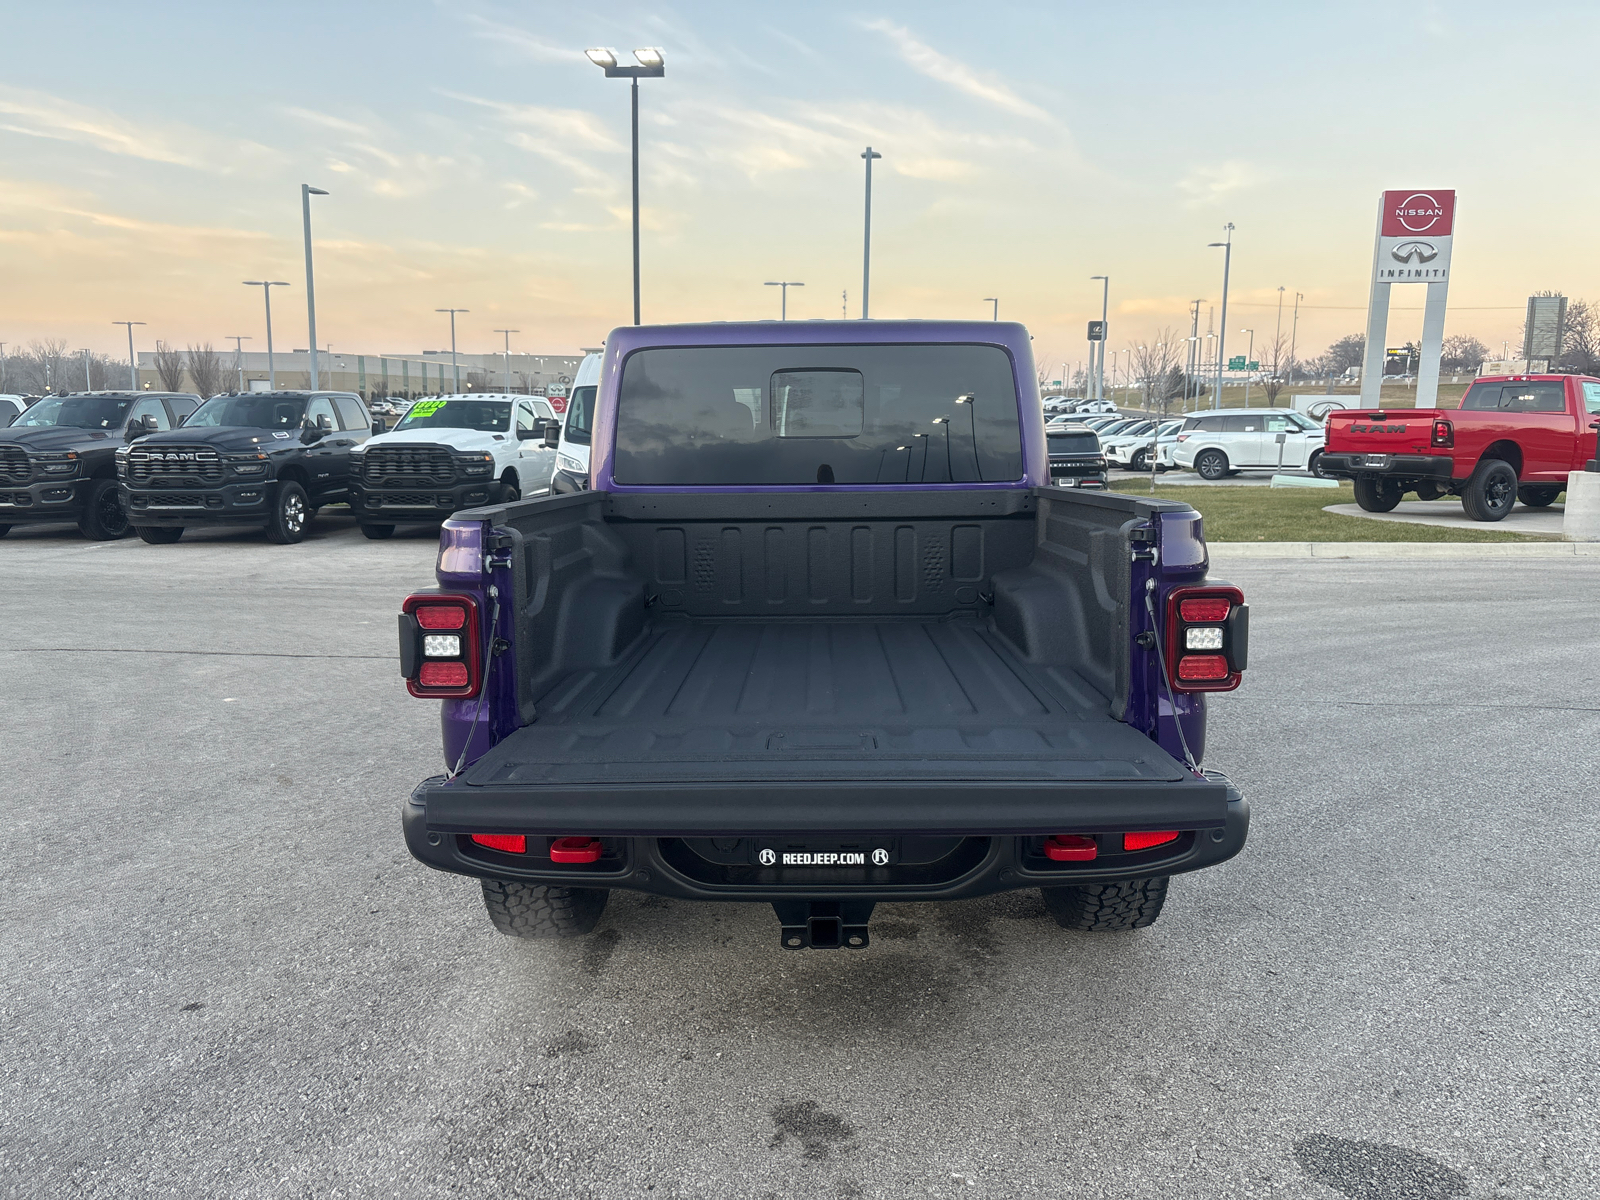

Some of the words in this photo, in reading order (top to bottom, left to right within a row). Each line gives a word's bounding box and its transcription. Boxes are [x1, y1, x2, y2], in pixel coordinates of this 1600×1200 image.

[1380, 269, 1446, 277] INFINITI
[1350, 424, 1406, 433] RAM
[149, 453, 195, 461] RAM
[782, 853, 865, 864] REEDJEEP.COM
